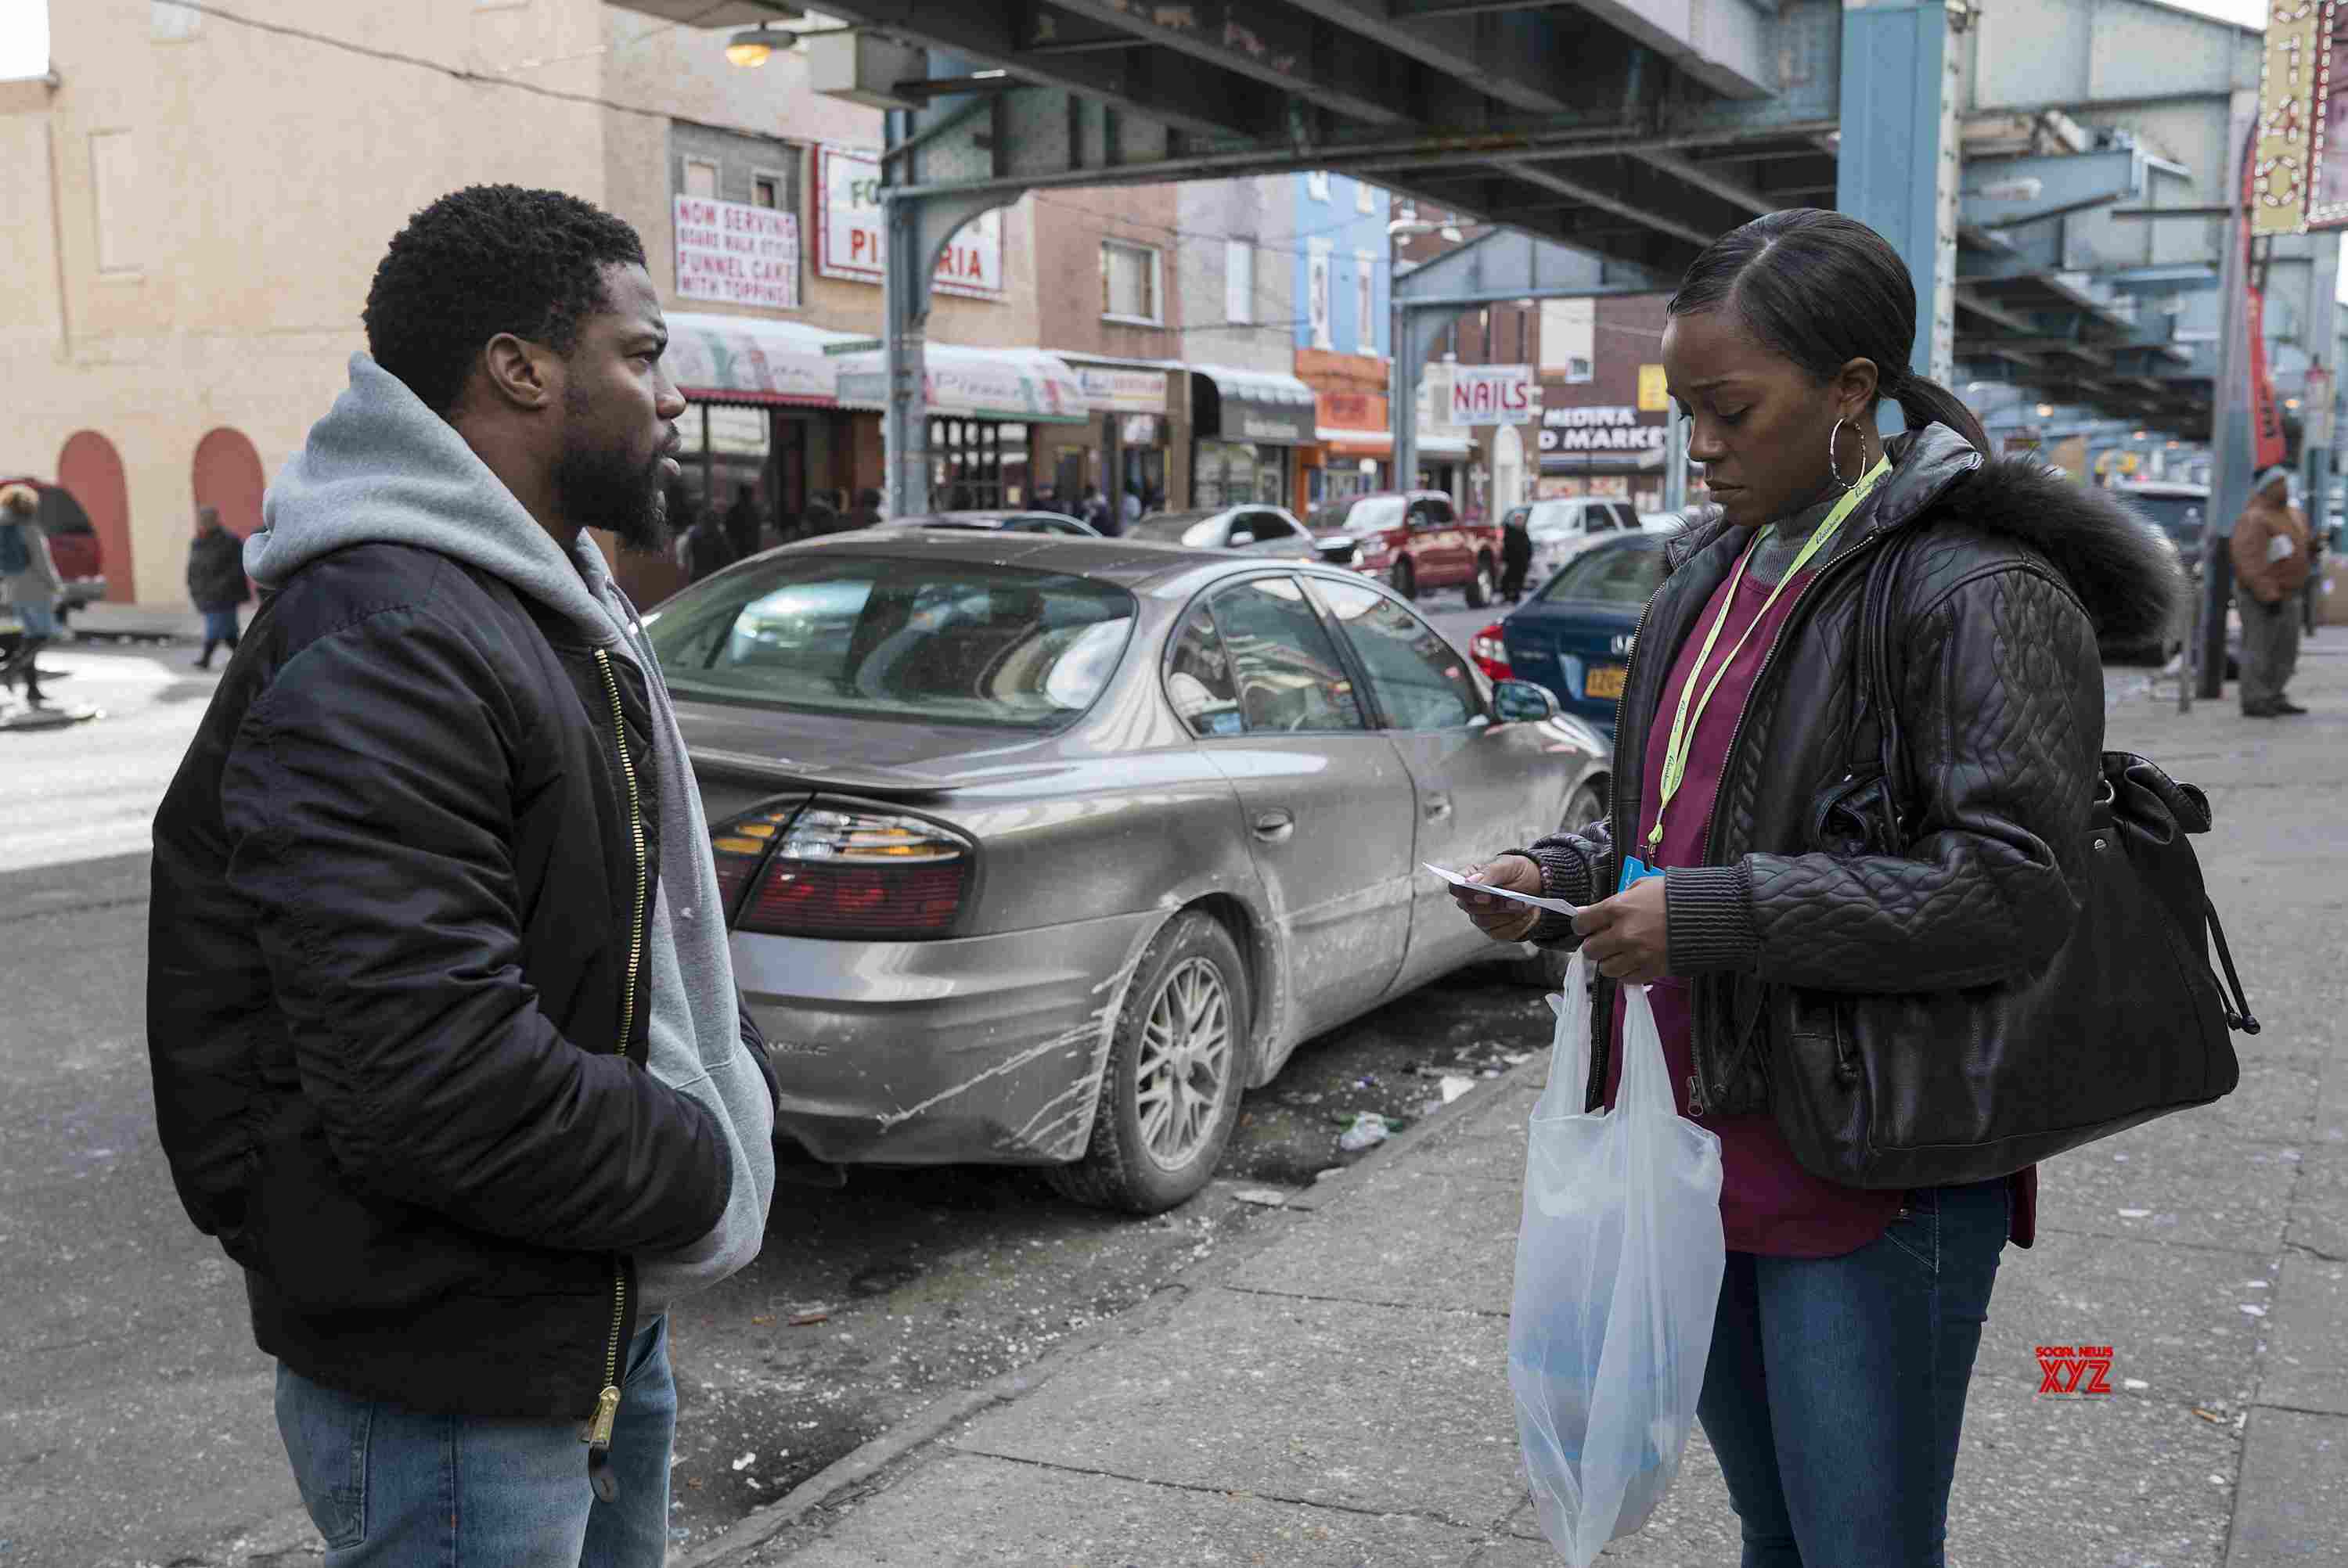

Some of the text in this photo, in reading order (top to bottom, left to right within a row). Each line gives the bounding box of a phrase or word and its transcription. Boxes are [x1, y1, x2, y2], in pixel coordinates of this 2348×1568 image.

[679, 199, 798, 239] NOW SERVING
[678, 250, 746, 278] FUNNEL
[850, 228, 982, 279] PIRIA
[682, 275, 718, 294] WITH
[1453, 381, 1528, 412] NAILS
[1563, 425, 1667, 451] MARKE
